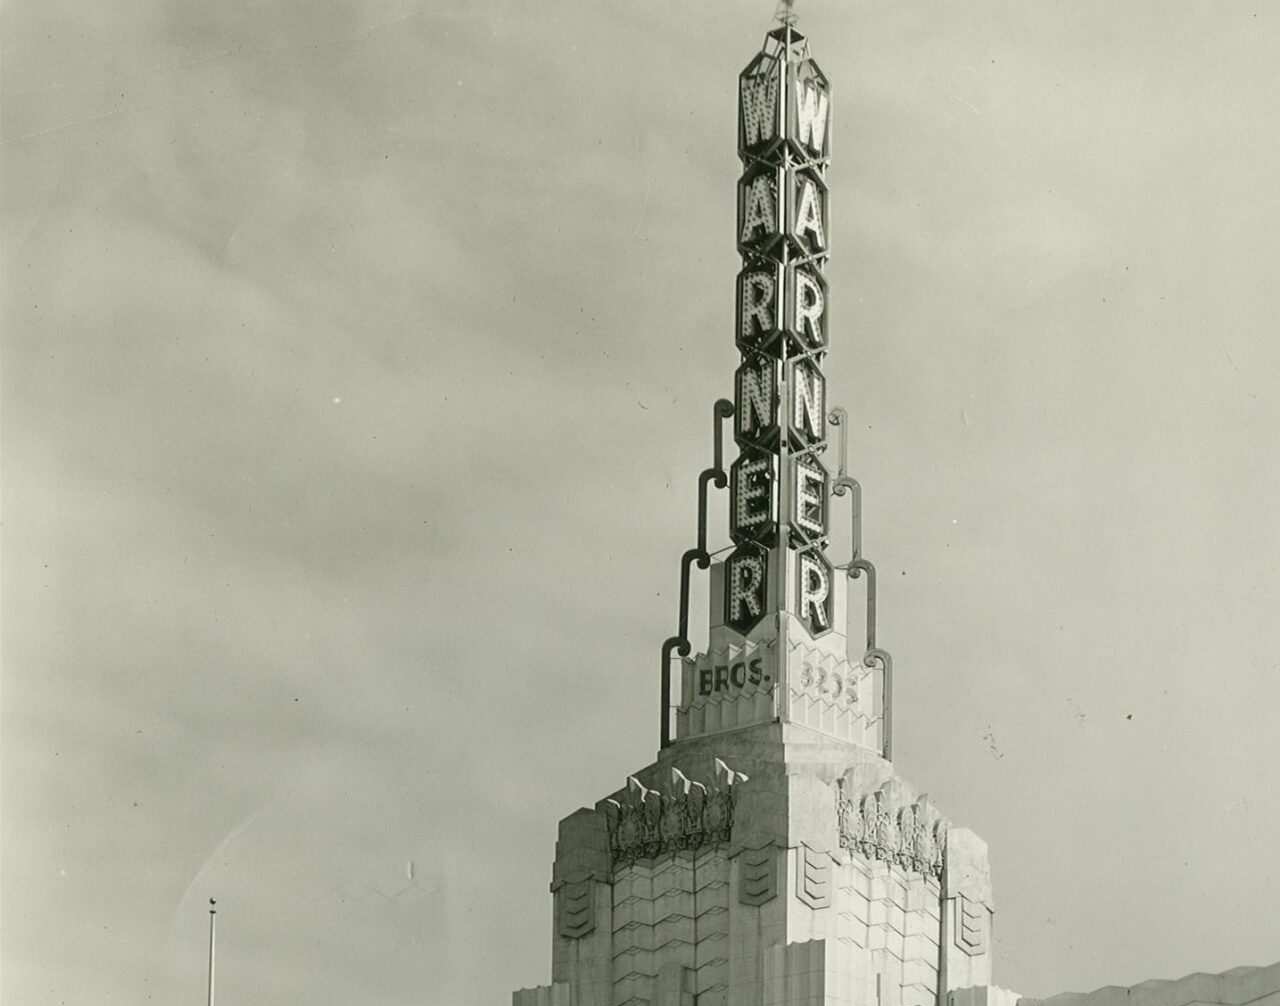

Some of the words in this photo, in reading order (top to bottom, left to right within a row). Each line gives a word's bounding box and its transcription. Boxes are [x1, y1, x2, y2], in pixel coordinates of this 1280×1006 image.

[730, 74, 778, 621] WARNER
[794, 79, 830, 628] WARNER
[699, 658, 770, 696] BROS.
